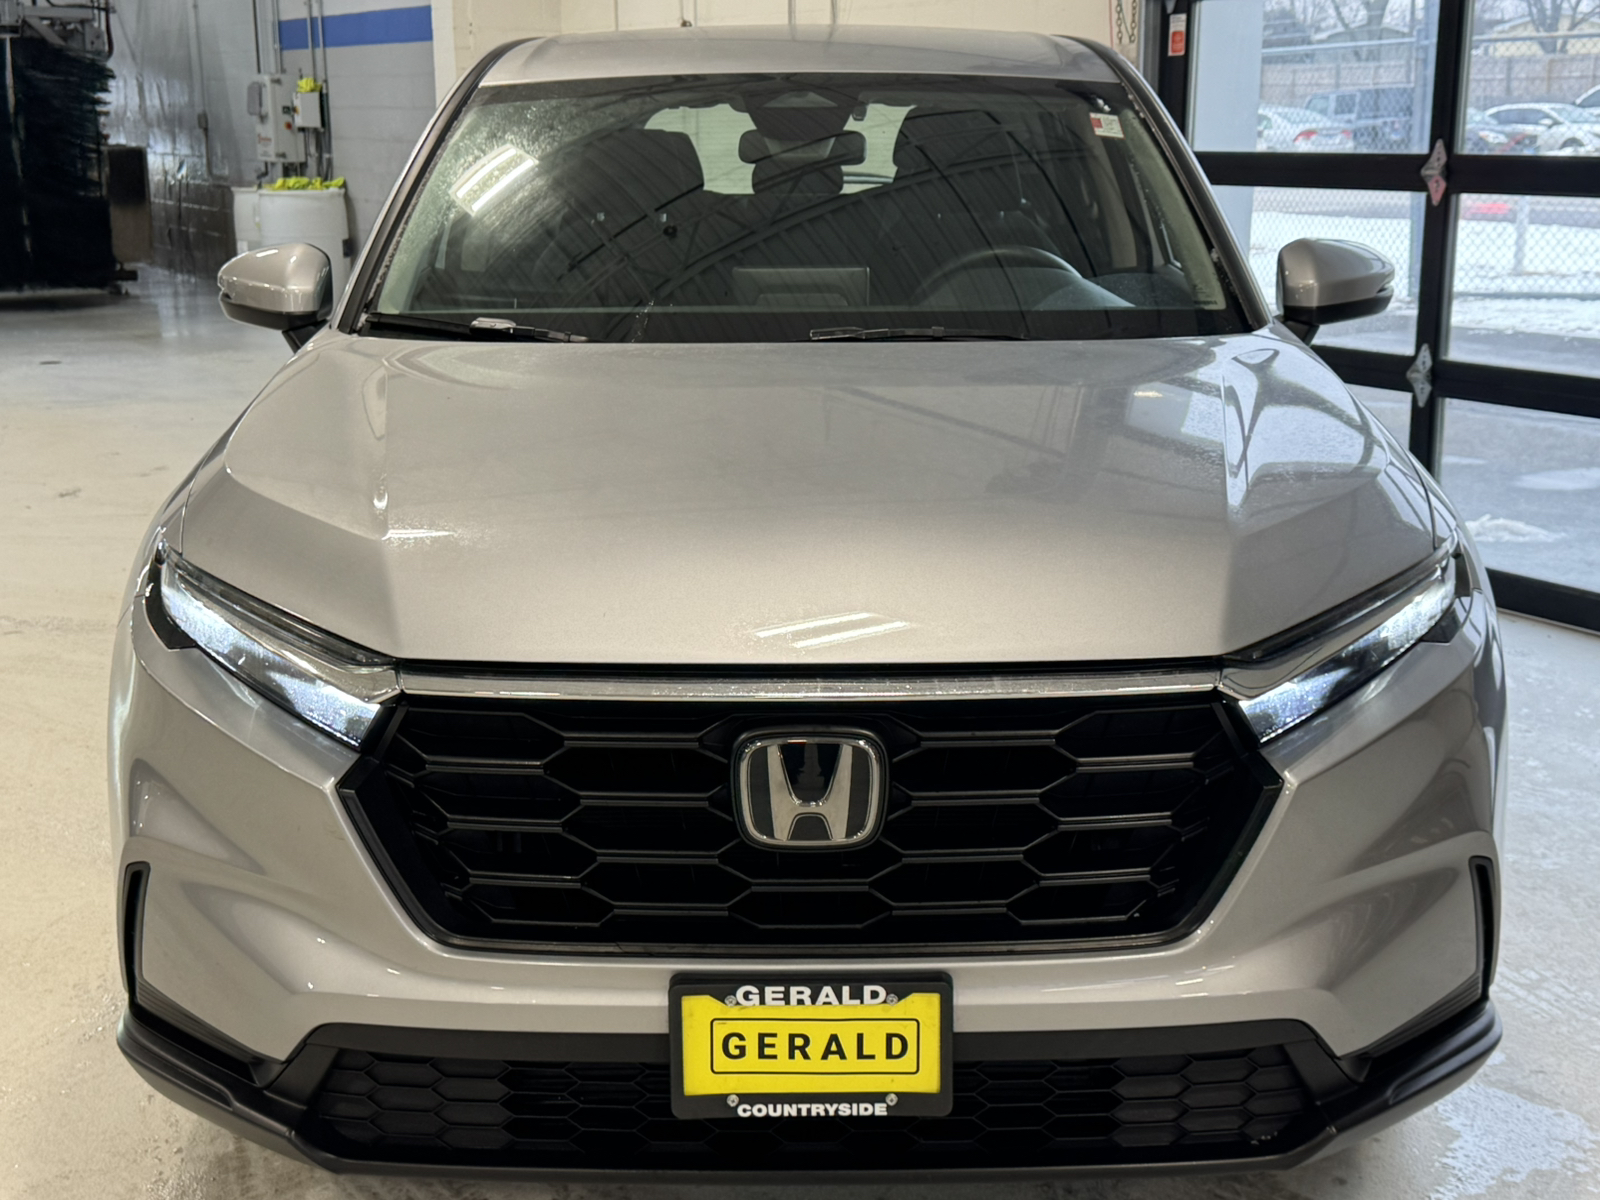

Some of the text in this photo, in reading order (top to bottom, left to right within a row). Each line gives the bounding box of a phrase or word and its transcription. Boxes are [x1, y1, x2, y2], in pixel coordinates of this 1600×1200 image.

[736, 985, 887, 1006] GERALD
[722, 1032, 909, 1060] GERALD
[737, 1103, 888, 1117] COUNTRYSIDE
